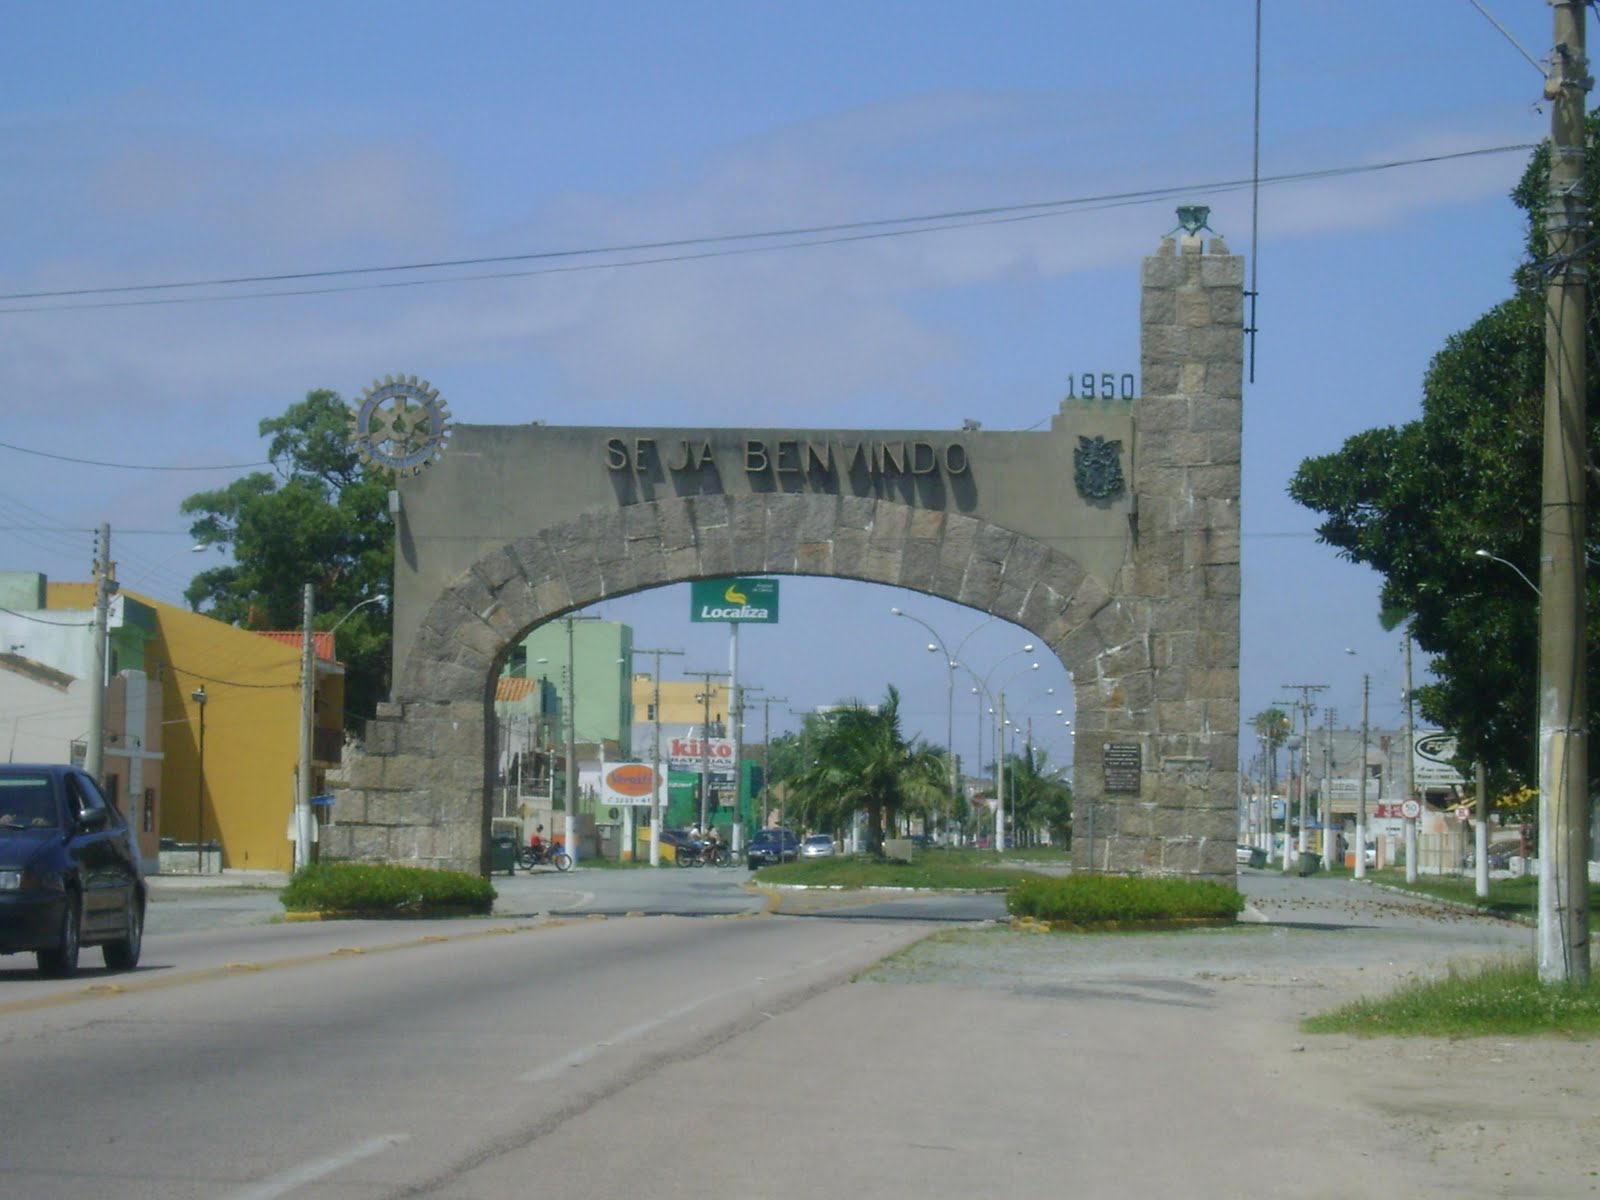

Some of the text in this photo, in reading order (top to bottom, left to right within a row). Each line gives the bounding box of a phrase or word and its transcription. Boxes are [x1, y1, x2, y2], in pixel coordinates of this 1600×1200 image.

[1067, 373, 1134, 400] 1950
[744, 439, 968, 474] BENVINDO
[701, 605, 768, 619] Localiza
[1405, 803, 1418, 812] 50
